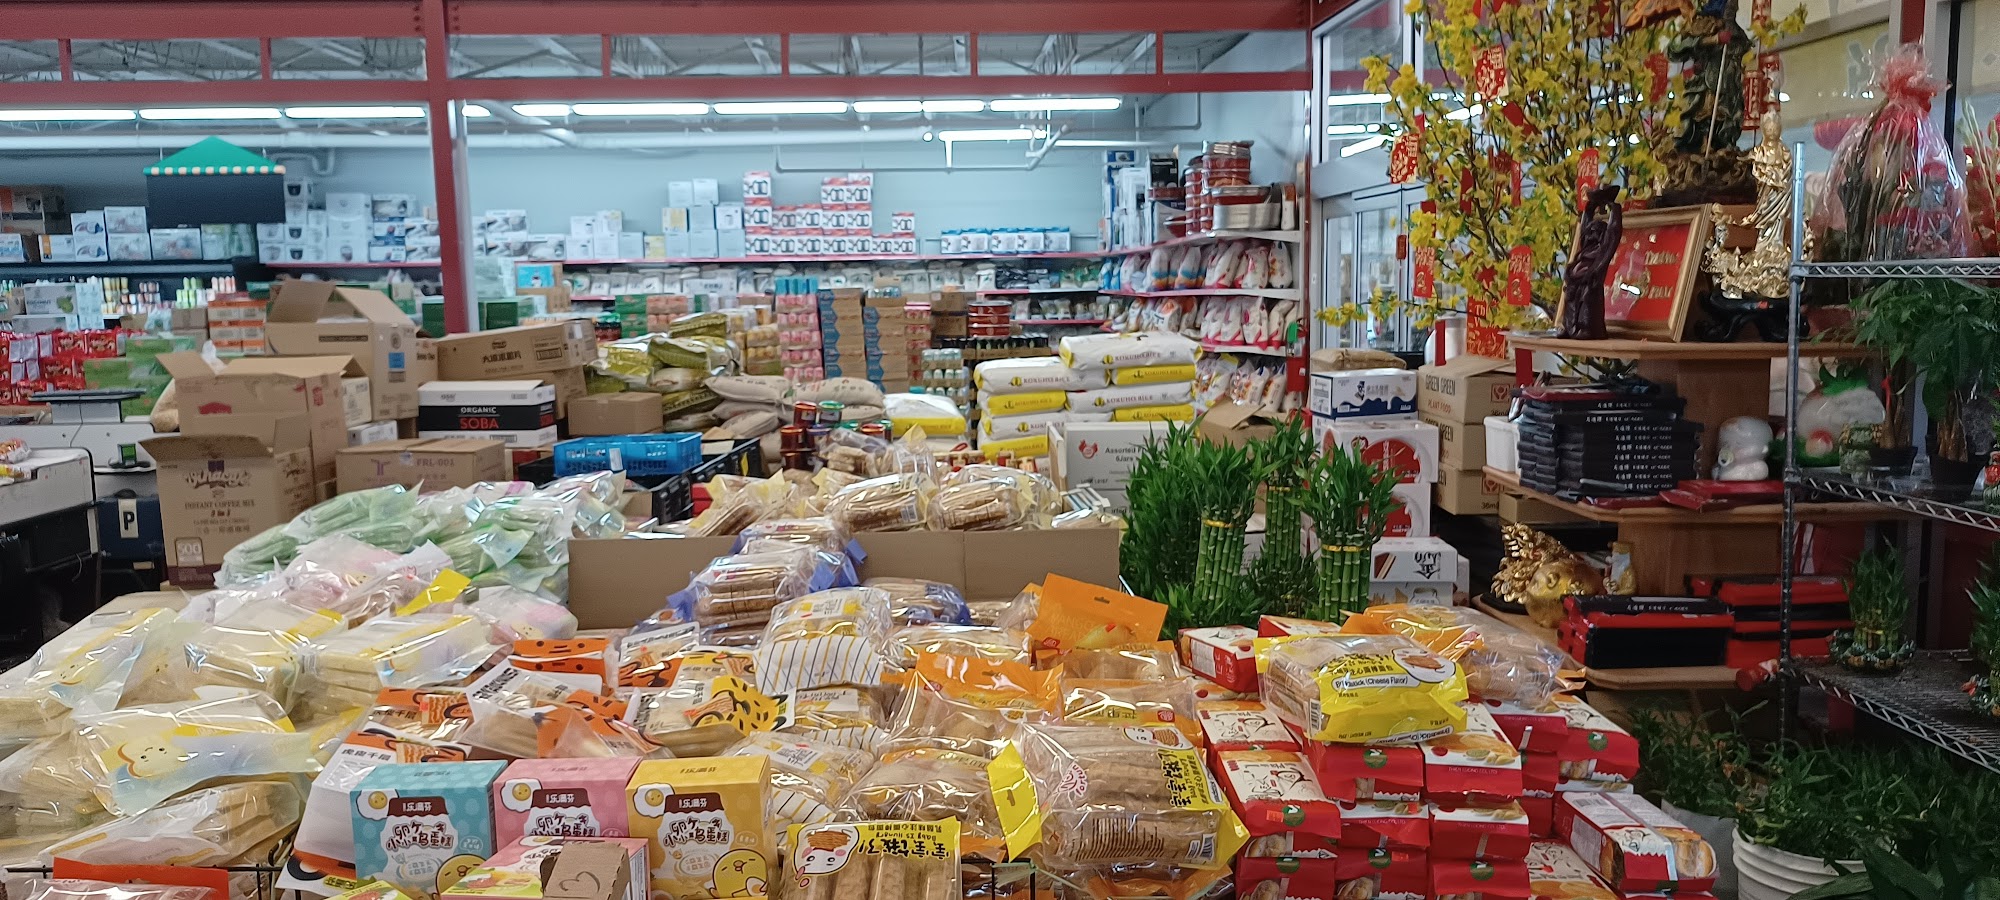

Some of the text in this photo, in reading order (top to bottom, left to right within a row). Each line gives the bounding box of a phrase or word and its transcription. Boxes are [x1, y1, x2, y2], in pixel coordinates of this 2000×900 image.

[1425, 374, 1456, 396] GREEN GREEN
[460, 417, 499, 429] SOBA
[122, 511, 136, 531] P
[918, 833, 937, 842] Baby
[858, 837, 951, 860] 宝宝饿了!
